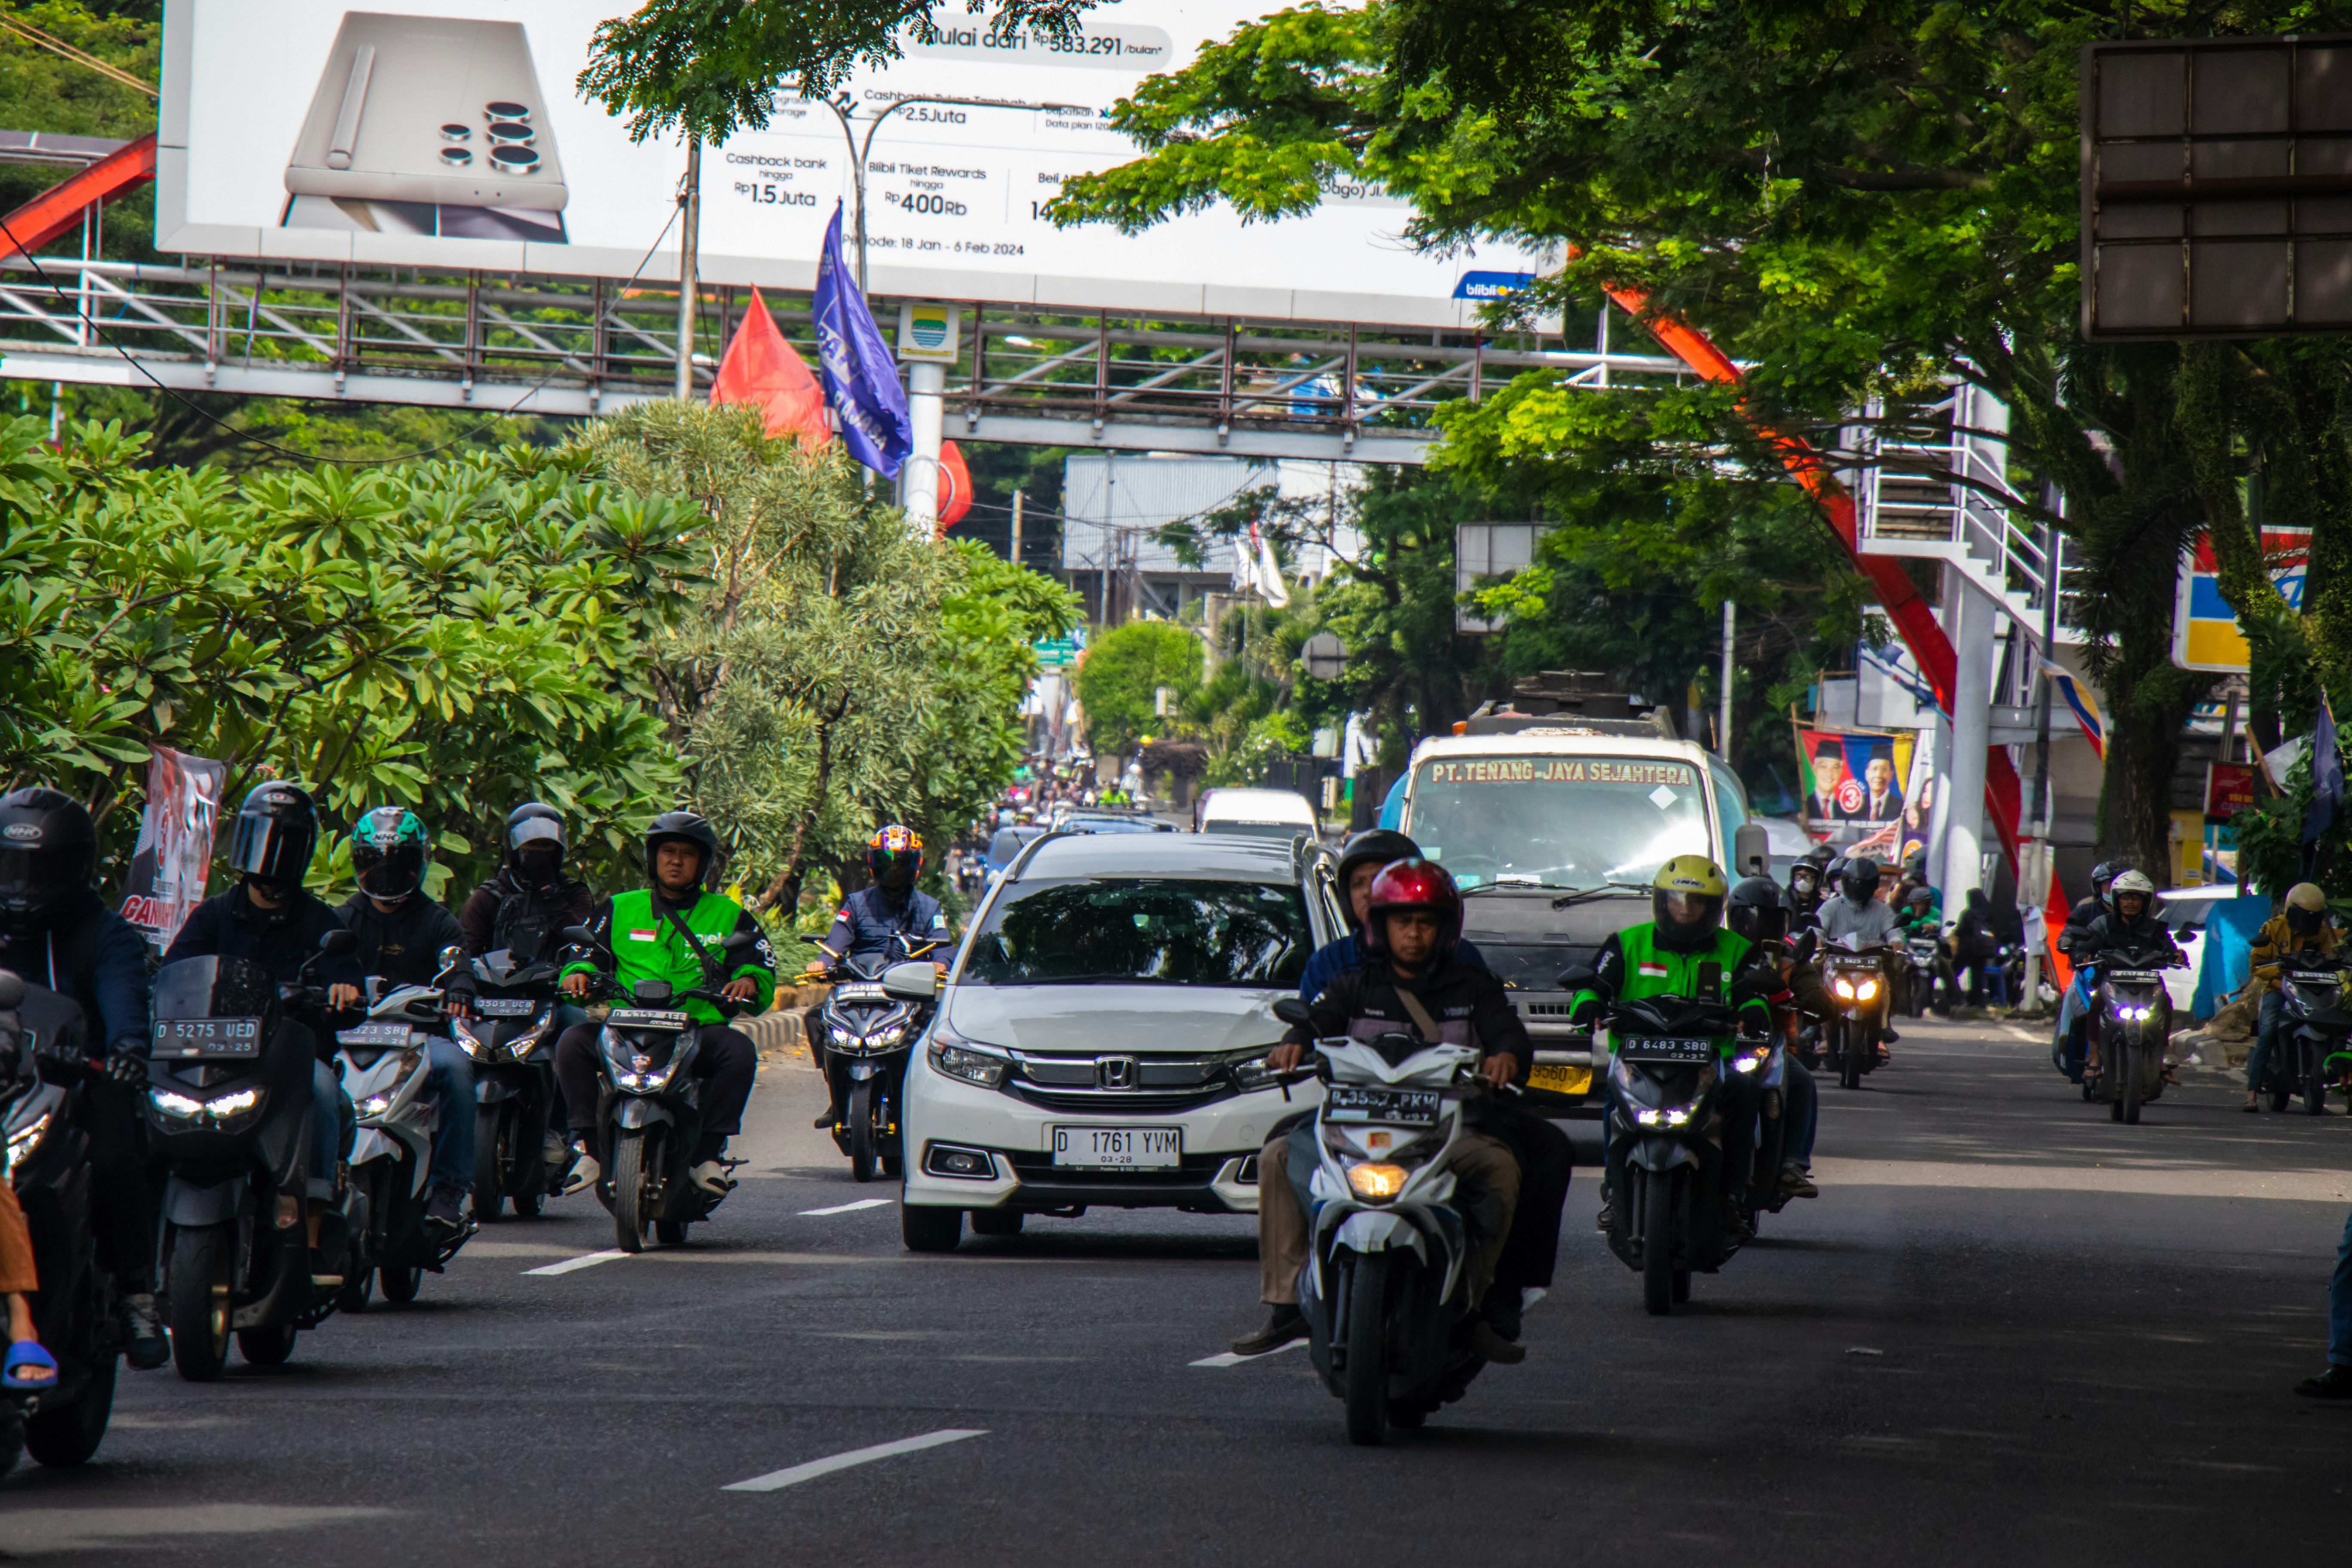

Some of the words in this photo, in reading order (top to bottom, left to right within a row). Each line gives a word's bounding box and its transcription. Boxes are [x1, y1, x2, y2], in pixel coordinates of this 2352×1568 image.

[928, 27, 977, 47] ulai
[982, 31, 1026, 50] dari
[772, 95, 811, 106] pgrade
[1046, 119, 1069, 129] Data
[1071, 120, 1092, 131] plan
[726, 153, 791, 167] Cashback
[795, 157, 827, 169] bank
[759, 170, 793, 182] hingga
[869, 162, 895, 173] Blibli
[898, 163, 928, 176] Tiket
[931, 166, 986, 180] Rewards
[1038, 173, 1059, 184] Beli
[910, 179, 943, 190] hingga
[778, 191, 816, 206] Juta
[902, 237, 913, 249] 18
[917, 239, 941, 251] Jan
[954, 241, 961, 252] 6
[965, 242, 989, 254] Feb
[994, 243, 1025, 256] 2024
[1466, 283, 1497, 296] blibli
[1432, 763, 1463, 782] PT.
[1464, 762, 1534, 781] TENANG
[1542, 762, 1586, 781] JAYA
[1589, 763, 1691, 786] SEJAHTERA
[157, 1024, 167, 1038] D
[176, 1023, 215, 1038] 5275
[225, 1023, 255, 1037] UED
[1629, 1039, 1636, 1049] D
[1643, 1040, 1675, 1049] 6483
[1400, 1093, 1436, 1110] PKM
[1057, 1131, 1068, 1152] D
[1092, 1132, 1131, 1153] 1761
[1142, 1132, 1177, 1153] YVM
